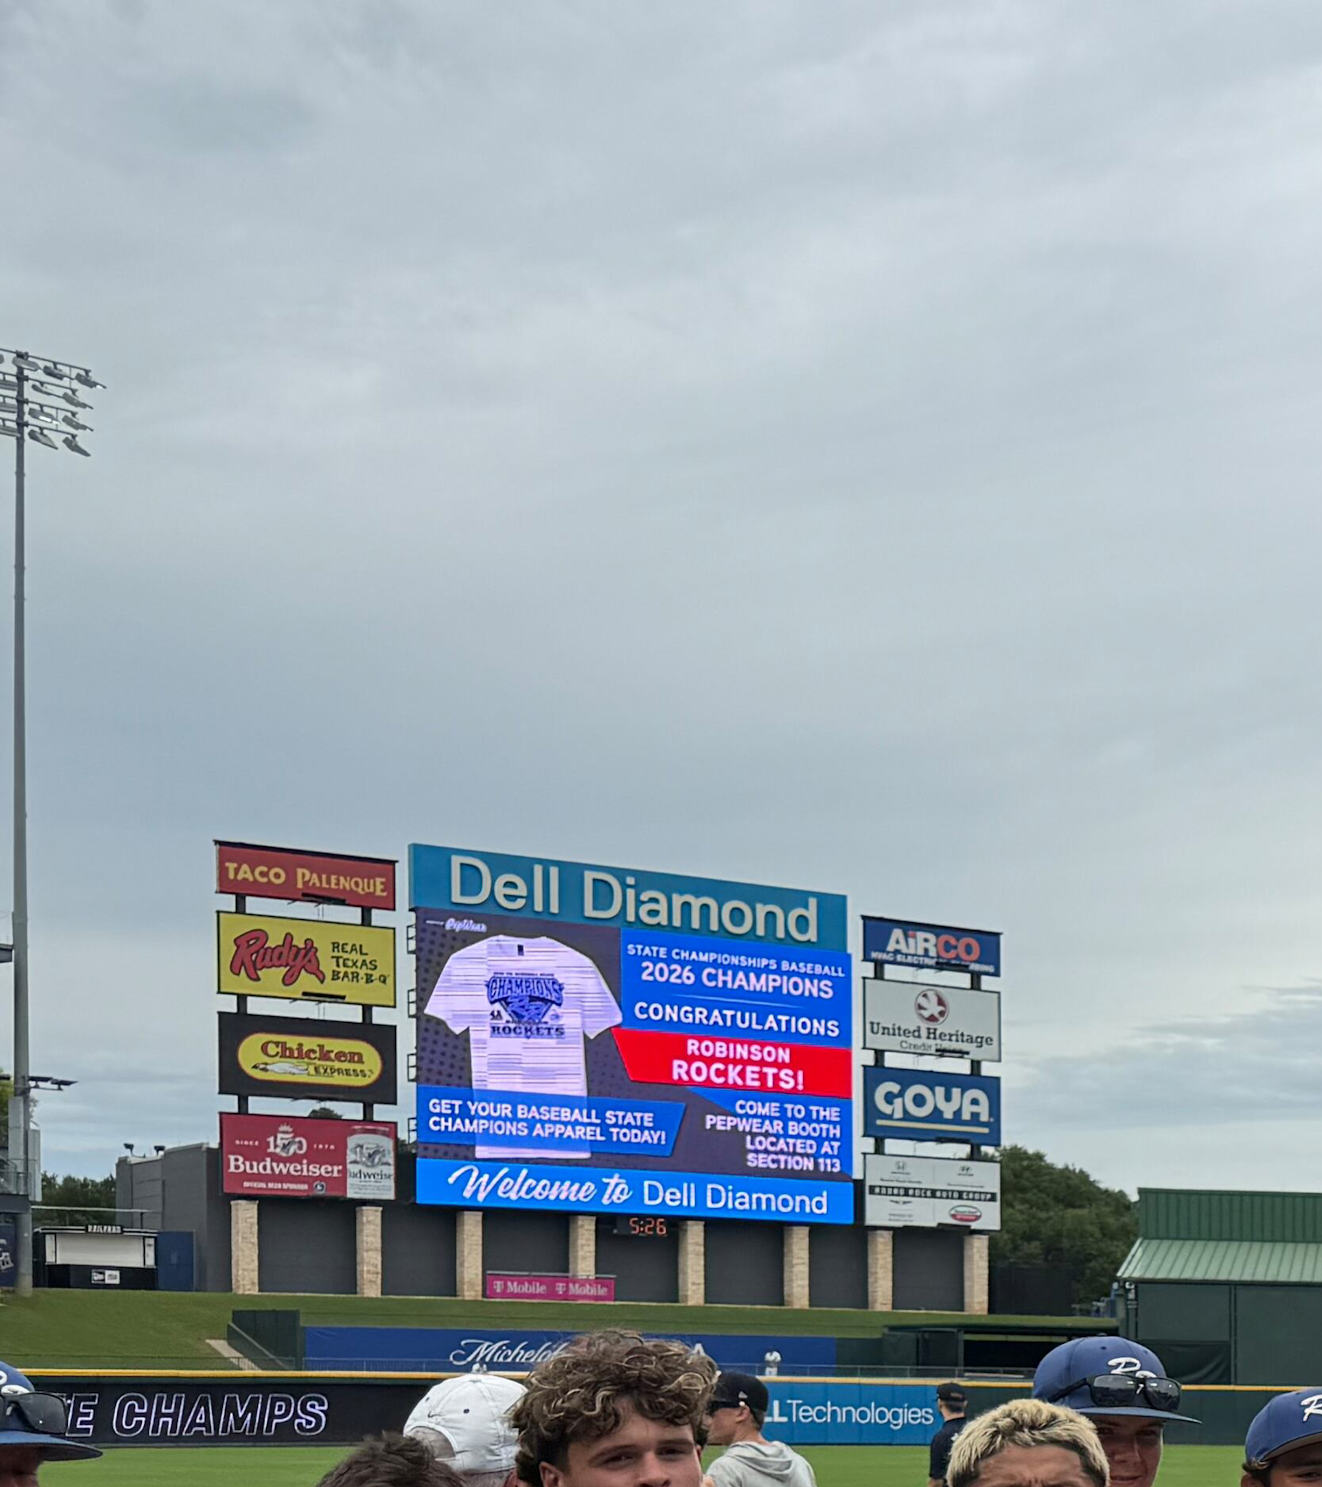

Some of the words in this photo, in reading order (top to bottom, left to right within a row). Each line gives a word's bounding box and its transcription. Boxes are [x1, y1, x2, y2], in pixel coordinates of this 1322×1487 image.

[225, 862, 286, 884] TACO
[296, 868, 387, 896] PALENQUE
[450, 854, 558, 914] Dell
[584, 870, 817, 942] Diamond
[230, 929, 325, 986] Rudy's
[332, 942, 368, 956] REAL
[627, 944, 667, 958] STATE
[672, 948, 777, 970] CHAMPIONSHIPS
[781, 960, 845, 977] BASEBALL
[332, 956, 378, 971] TEXAS
[490, 976, 562, 1003] CHAMPIONS
[641, 962, 696, 985] 2026
[701, 968, 834, 999] CHAMPIONS
[491, 1025, 565, 1037] ROCKETS
[634, 1002, 840, 1037] CONGRATULATIONS
[870, 1021, 922, 1039] United
[926, 1028, 994, 1048] Heritage
[261, 1040, 364, 1064] Chicken
[687, 1039, 790, 1063] ROBINSON
[672, 1059, 804, 1090] ROCKETS!
[428, 1098, 463, 1116] GET
[467, 1101, 513, 1119] YOUR
[517, 1104, 600, 1124] BASEBALL
[605, 1110, 653, 1128] STATE
[736, 1100, 781, 1117] COME
[786, 1103, 806, 1119] TO
[811, 1104, 841, 1122] THE
[874, 1081, 990, 1122] GOYA
[428, 1116, 528, 1137] CHAMPIONS
[533, 1121, 605, 1141] APPAREL
[609, 1126, 666, 1145] TODAY!
[705, 1114, 784, 1135] PEPWEAR
[788, 1120, 841, 1138] BOOTH
[746, 1136, 817, 1154] LOCATED
[820, 1139, 841, 1155] AT
[228, 1154, 342, 1178] Budweiser
[747, 1152, 815, 1172] SECTION
[818, 1156, 841, 1173] 113
[448, 1164, 597, 1202] Welcome
[601, 1173, 634, 1204] to
[643, 1180, 696, 1208] Dell
[707, 1182, 828, 1215] Diamond
[629, 1218, 666, 1235] 5:26
[506, 1280, 547, 1295] Mobile
[568, 1282, 608, 1297] Mobile
[113, 1393, 328, 1437] CHAMPS
[787, 1400, 934, 1430] Technologies
